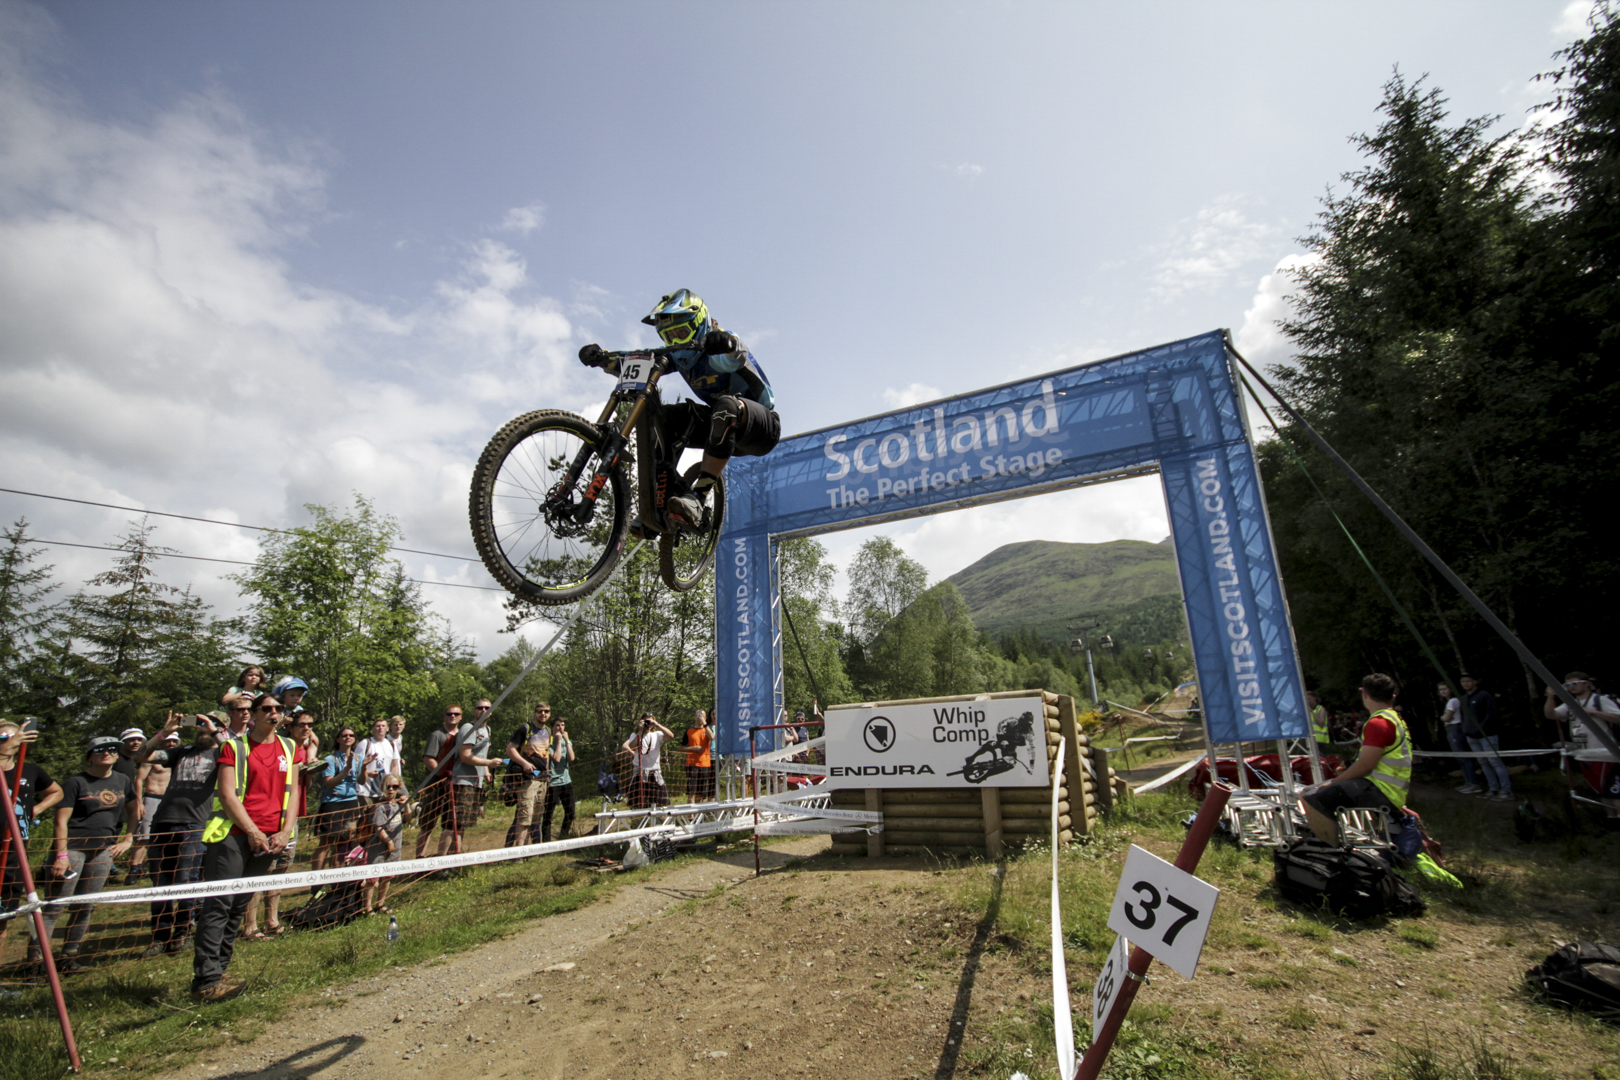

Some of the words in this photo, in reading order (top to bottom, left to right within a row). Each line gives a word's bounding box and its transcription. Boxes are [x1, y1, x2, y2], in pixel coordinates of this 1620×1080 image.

[622, 364, 641, 380] 45
[824, 380, 1059, 482] Scotland
[584, 472, 608, 502] FOX
[826, 484, 869, 510] The
[877, 462, 971, 500] Perfect
[980, 446, 1063, 478] Stage
[1196, 456, 1267, 726] VISITSCOTLAND.COM
[734, 537, 751, 742] VISITSCOTLAND.COM
[933, 706, 986, 728] Whip
[933, 726, 990, 746] Comp
[830, 764, 935, 777] ENDURA
[246, 876, 303, 889] Mercedes-Benz
[319, 869, 368, 881] Mercedes-Benz
[382, 862, 425, 874] Mercedes-Benz
[437, 856, 475, 866] Mercedes-Benz
[1124, 880, 1199, 947] 37
[1097, 959, 1114, 1020] 38
